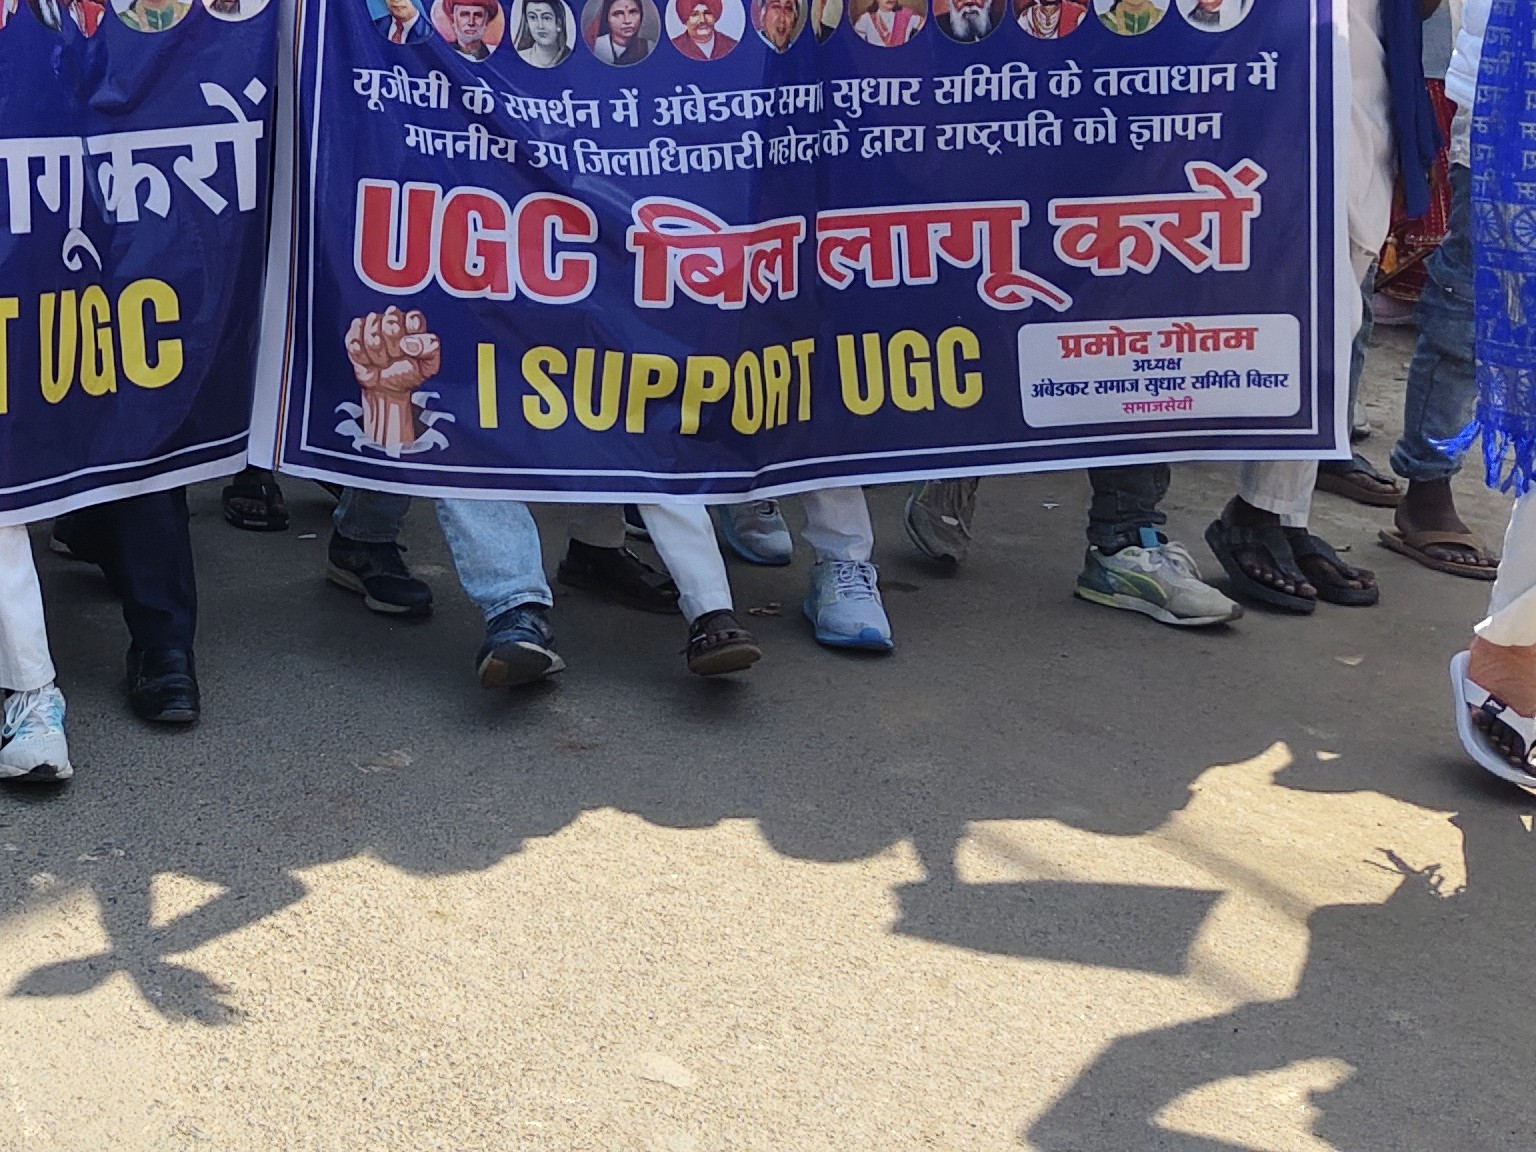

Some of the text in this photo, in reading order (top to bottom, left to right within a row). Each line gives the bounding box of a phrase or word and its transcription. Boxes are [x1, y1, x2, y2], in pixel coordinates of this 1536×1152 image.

[353, 64, 451, 111] यूजीसी
[461, 77, 495, 115] के
[500, 89, 600, 129] समर्थन
[610, 88, 640, 128] में
[653, 84, 776, 125] अंबेडकर
[831, 77, 922, 118] सुधार
[934, 61, 1036, 104] समिति
[1048, 60, 1083, 98] के
[1093, 61, 1237, 97] तत्वाधान
[1247, 52, 1279, 91] में
[84, 77, 267, 224] करों
[404, 123, 518, 163] माननीय
[528, 139, 570, 171] उप
[573, 134, 764, 176] जिलाधिकारी
[822, 119, 850, 156] के
[858, 125, 926, 159] द्वारा
[936, 111, 1064, 155] राष्ट्रपति
[1073, 108, 1119, 144] को
[1129, 112, 1223, 149] ज्ञापन
[353, 158, 1267, 312] UGC बिल लागू करों
[39, 278, 183, 405] UGC
[1057, 322, 1259, 359] प्रमोद गौतम
[1132, 357, 1182, 373] अध्यक्ष
[477, 326, 984, 436] I SUPPORT UGC
[1031, 369, 1289, 398] अंबेडकर समाज सुधार समिति बिहार
[1122, 396, 1193, 414] समाजसेवी
